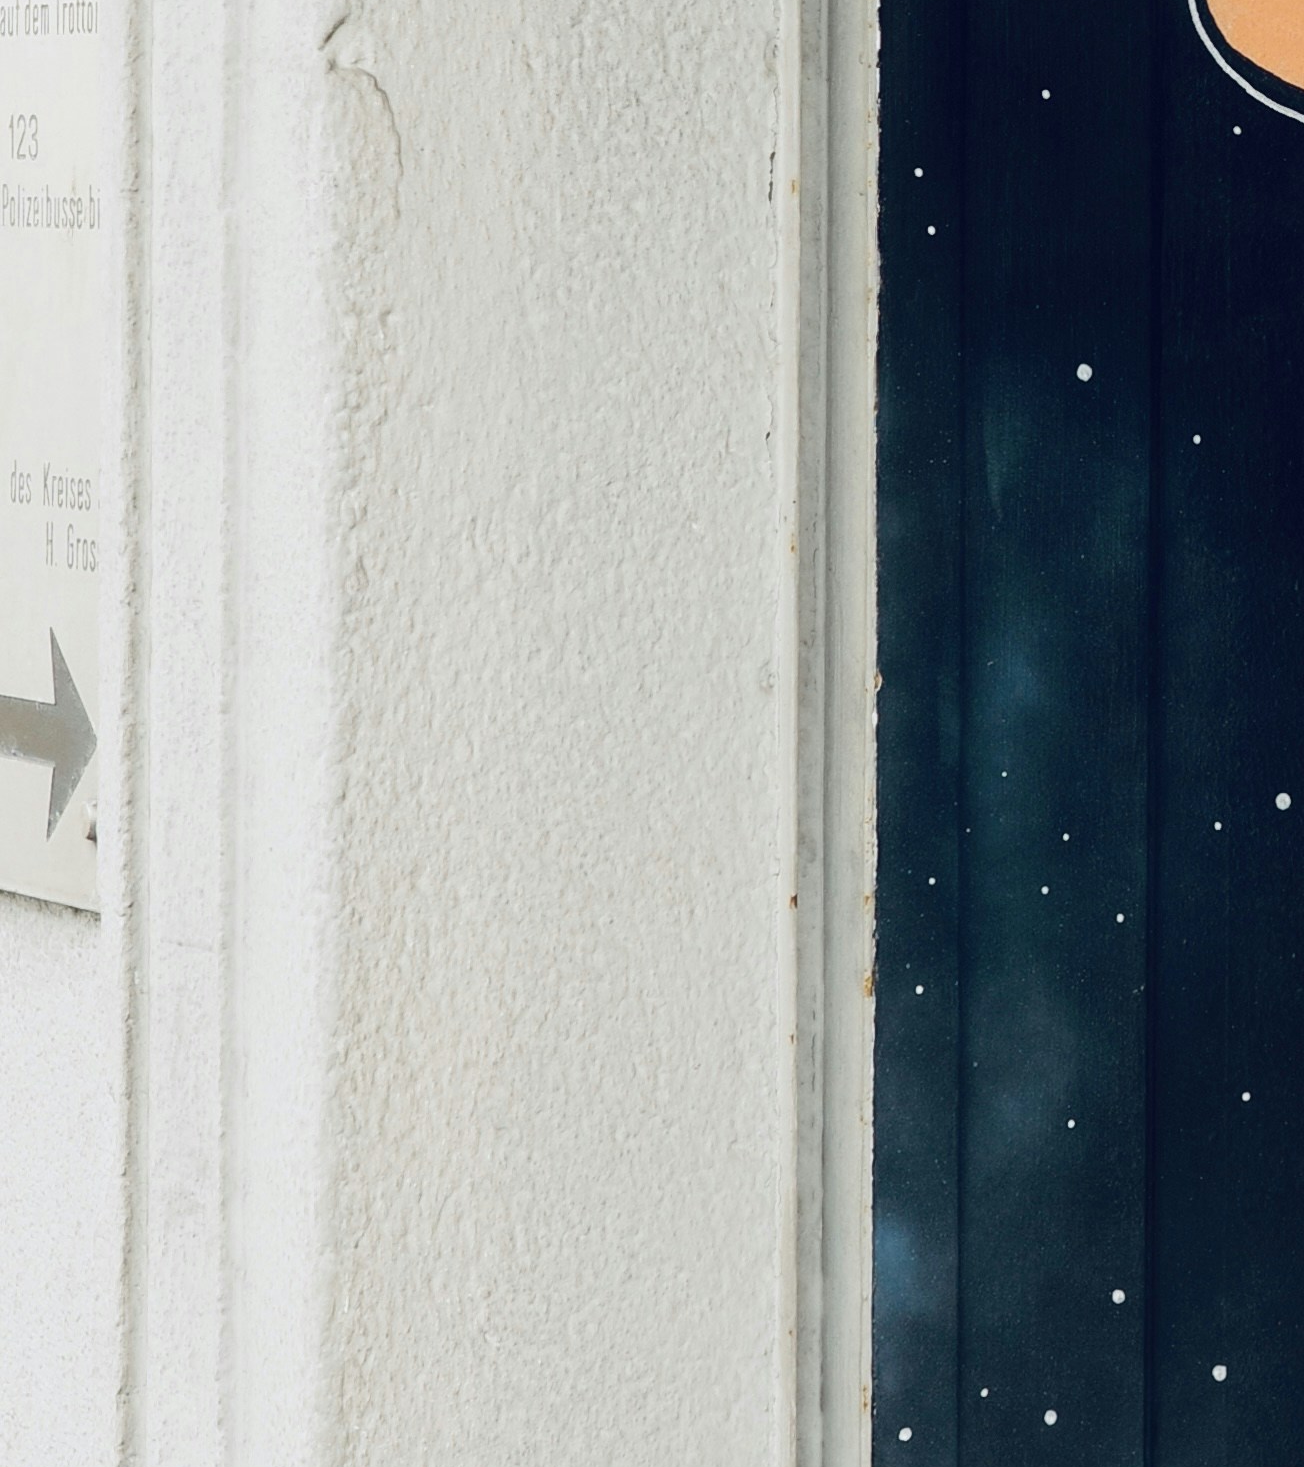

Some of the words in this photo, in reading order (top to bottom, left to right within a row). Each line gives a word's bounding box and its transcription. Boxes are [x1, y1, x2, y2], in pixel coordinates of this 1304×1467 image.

[8, 113, 39, 162] 123
[2, 183, 83, 230] Polizeibusse
[10, 459, 32, 506] des
[42, 461, 92, 512] Kreises
